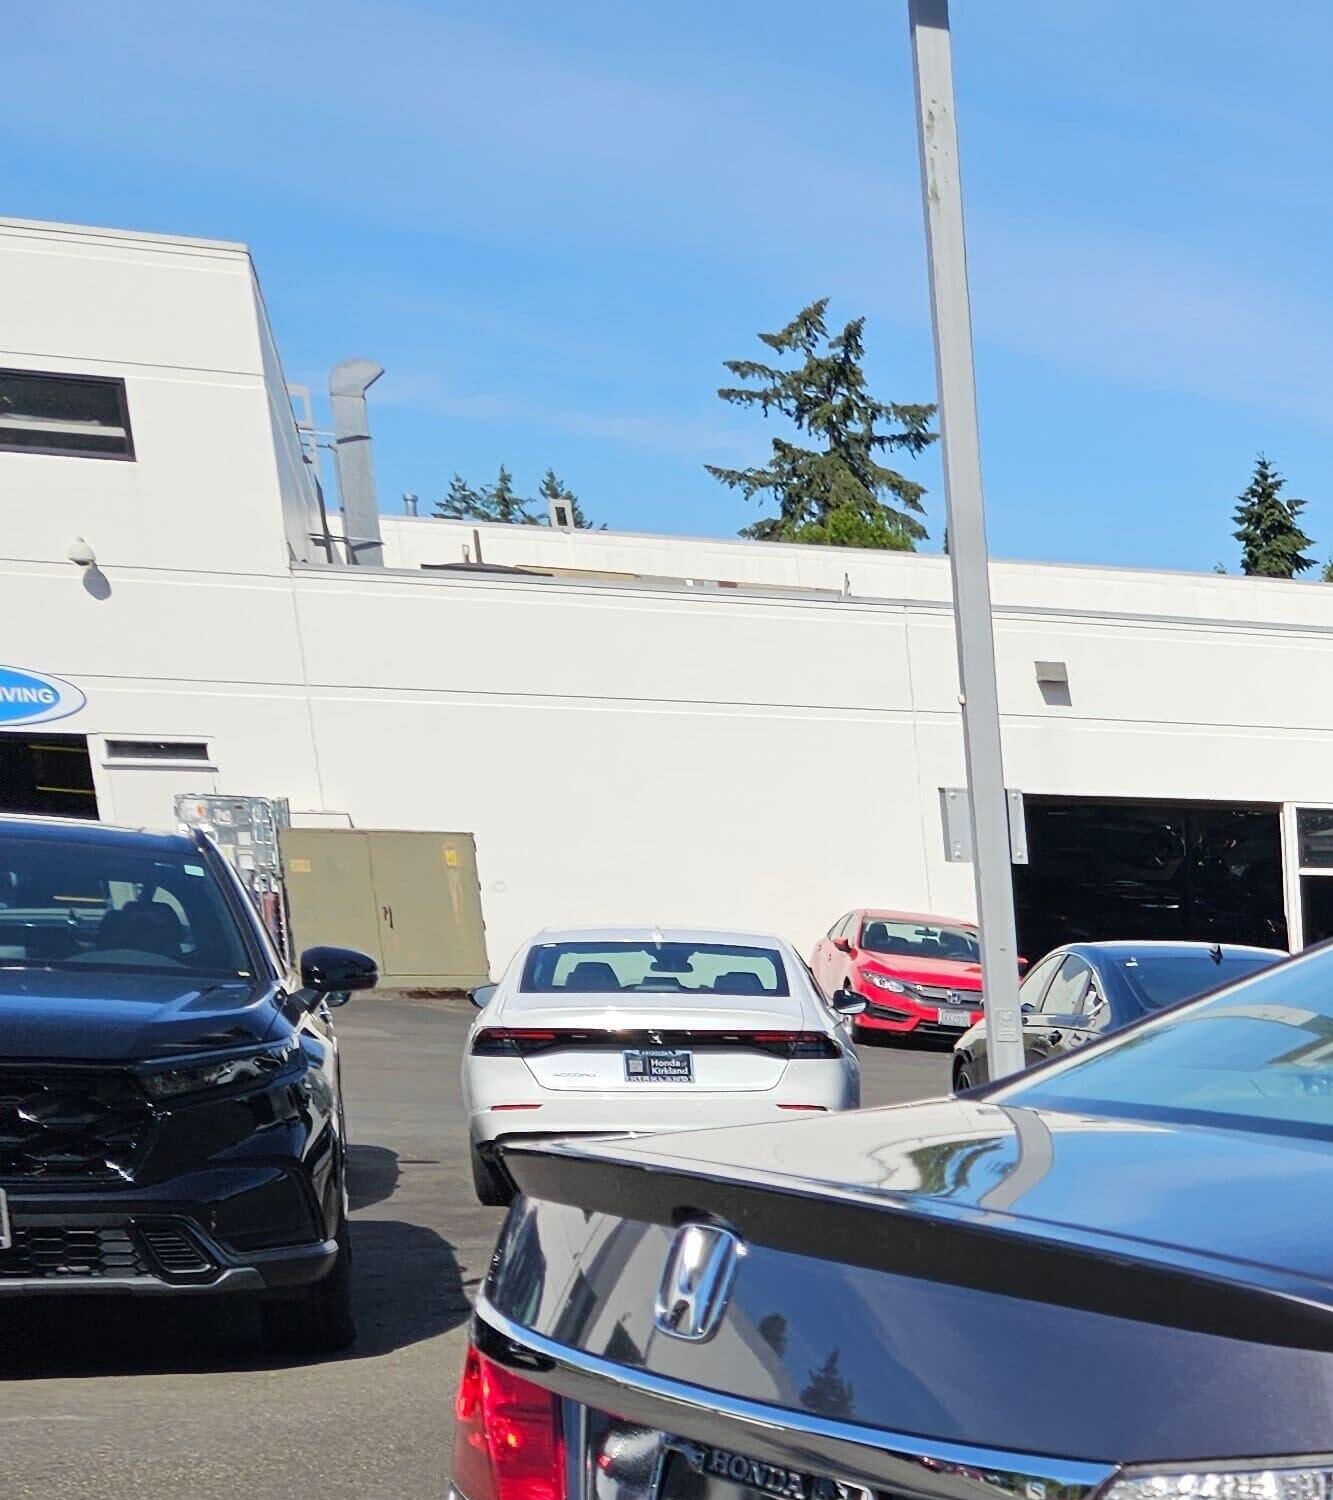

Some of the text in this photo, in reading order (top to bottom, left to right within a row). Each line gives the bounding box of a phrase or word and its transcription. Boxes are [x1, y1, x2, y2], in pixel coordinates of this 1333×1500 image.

[650, 1059, 681, 1067] Honda
[651, 1067, 688, 1075] Kirkland
[709, 1450, 805, 1500] HONDA
